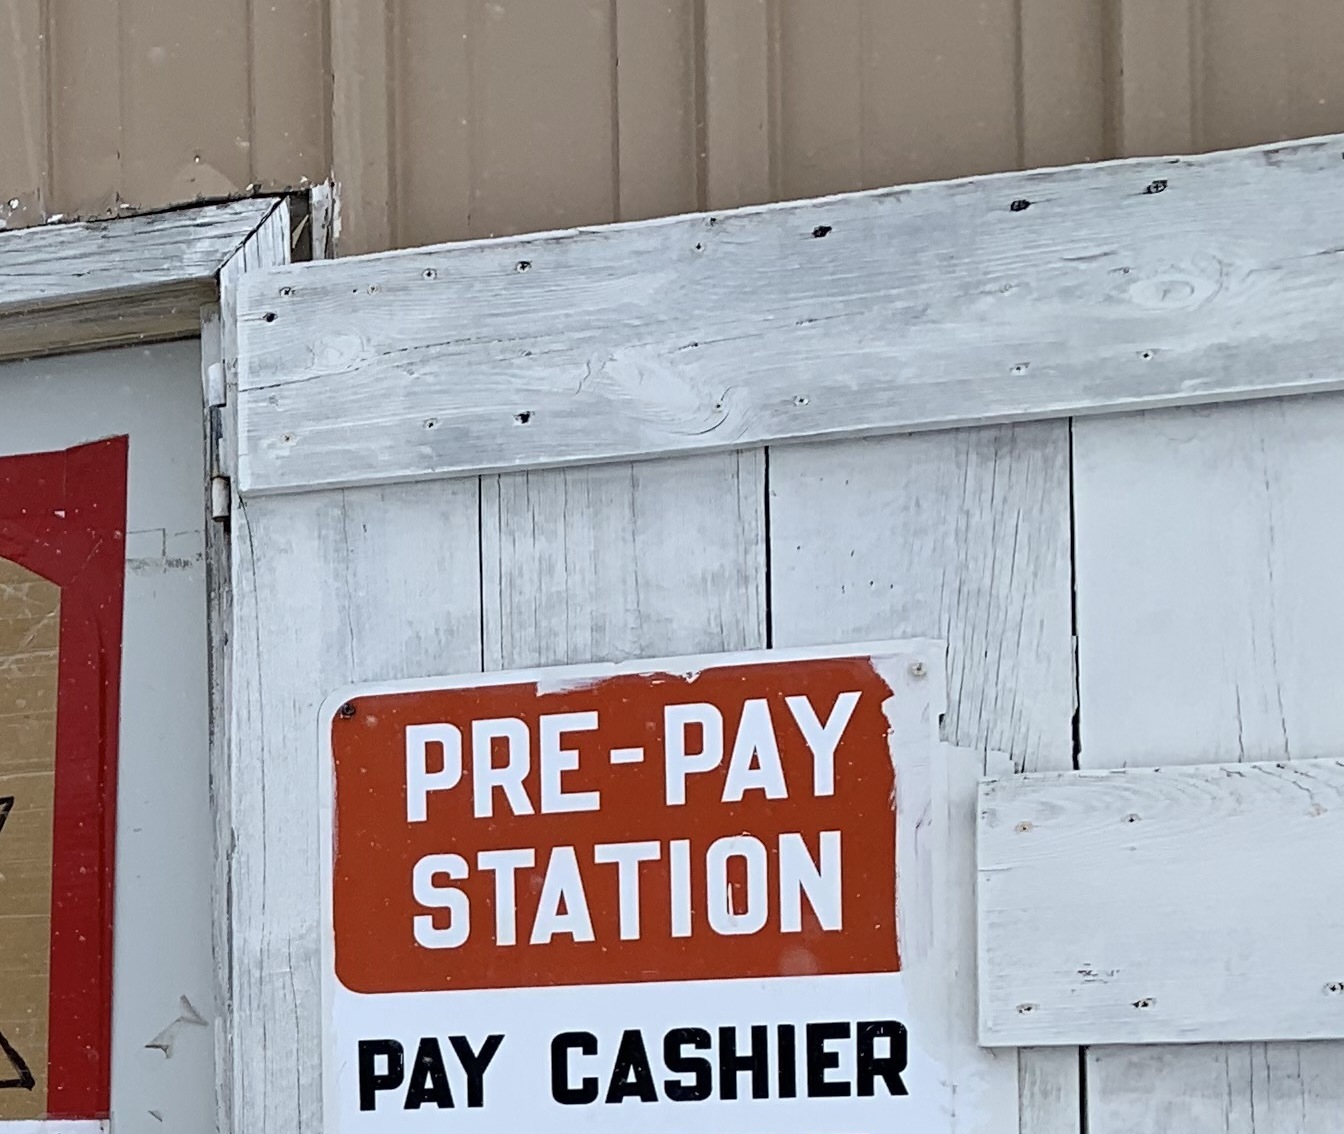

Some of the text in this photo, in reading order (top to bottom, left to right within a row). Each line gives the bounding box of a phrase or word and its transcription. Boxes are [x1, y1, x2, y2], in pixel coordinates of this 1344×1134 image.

[405, 690, 862, 823] PRE-PAY
[411, 830, 844, 951] STATION
[357, 1020, 909, 1113] PAY CASHIER
